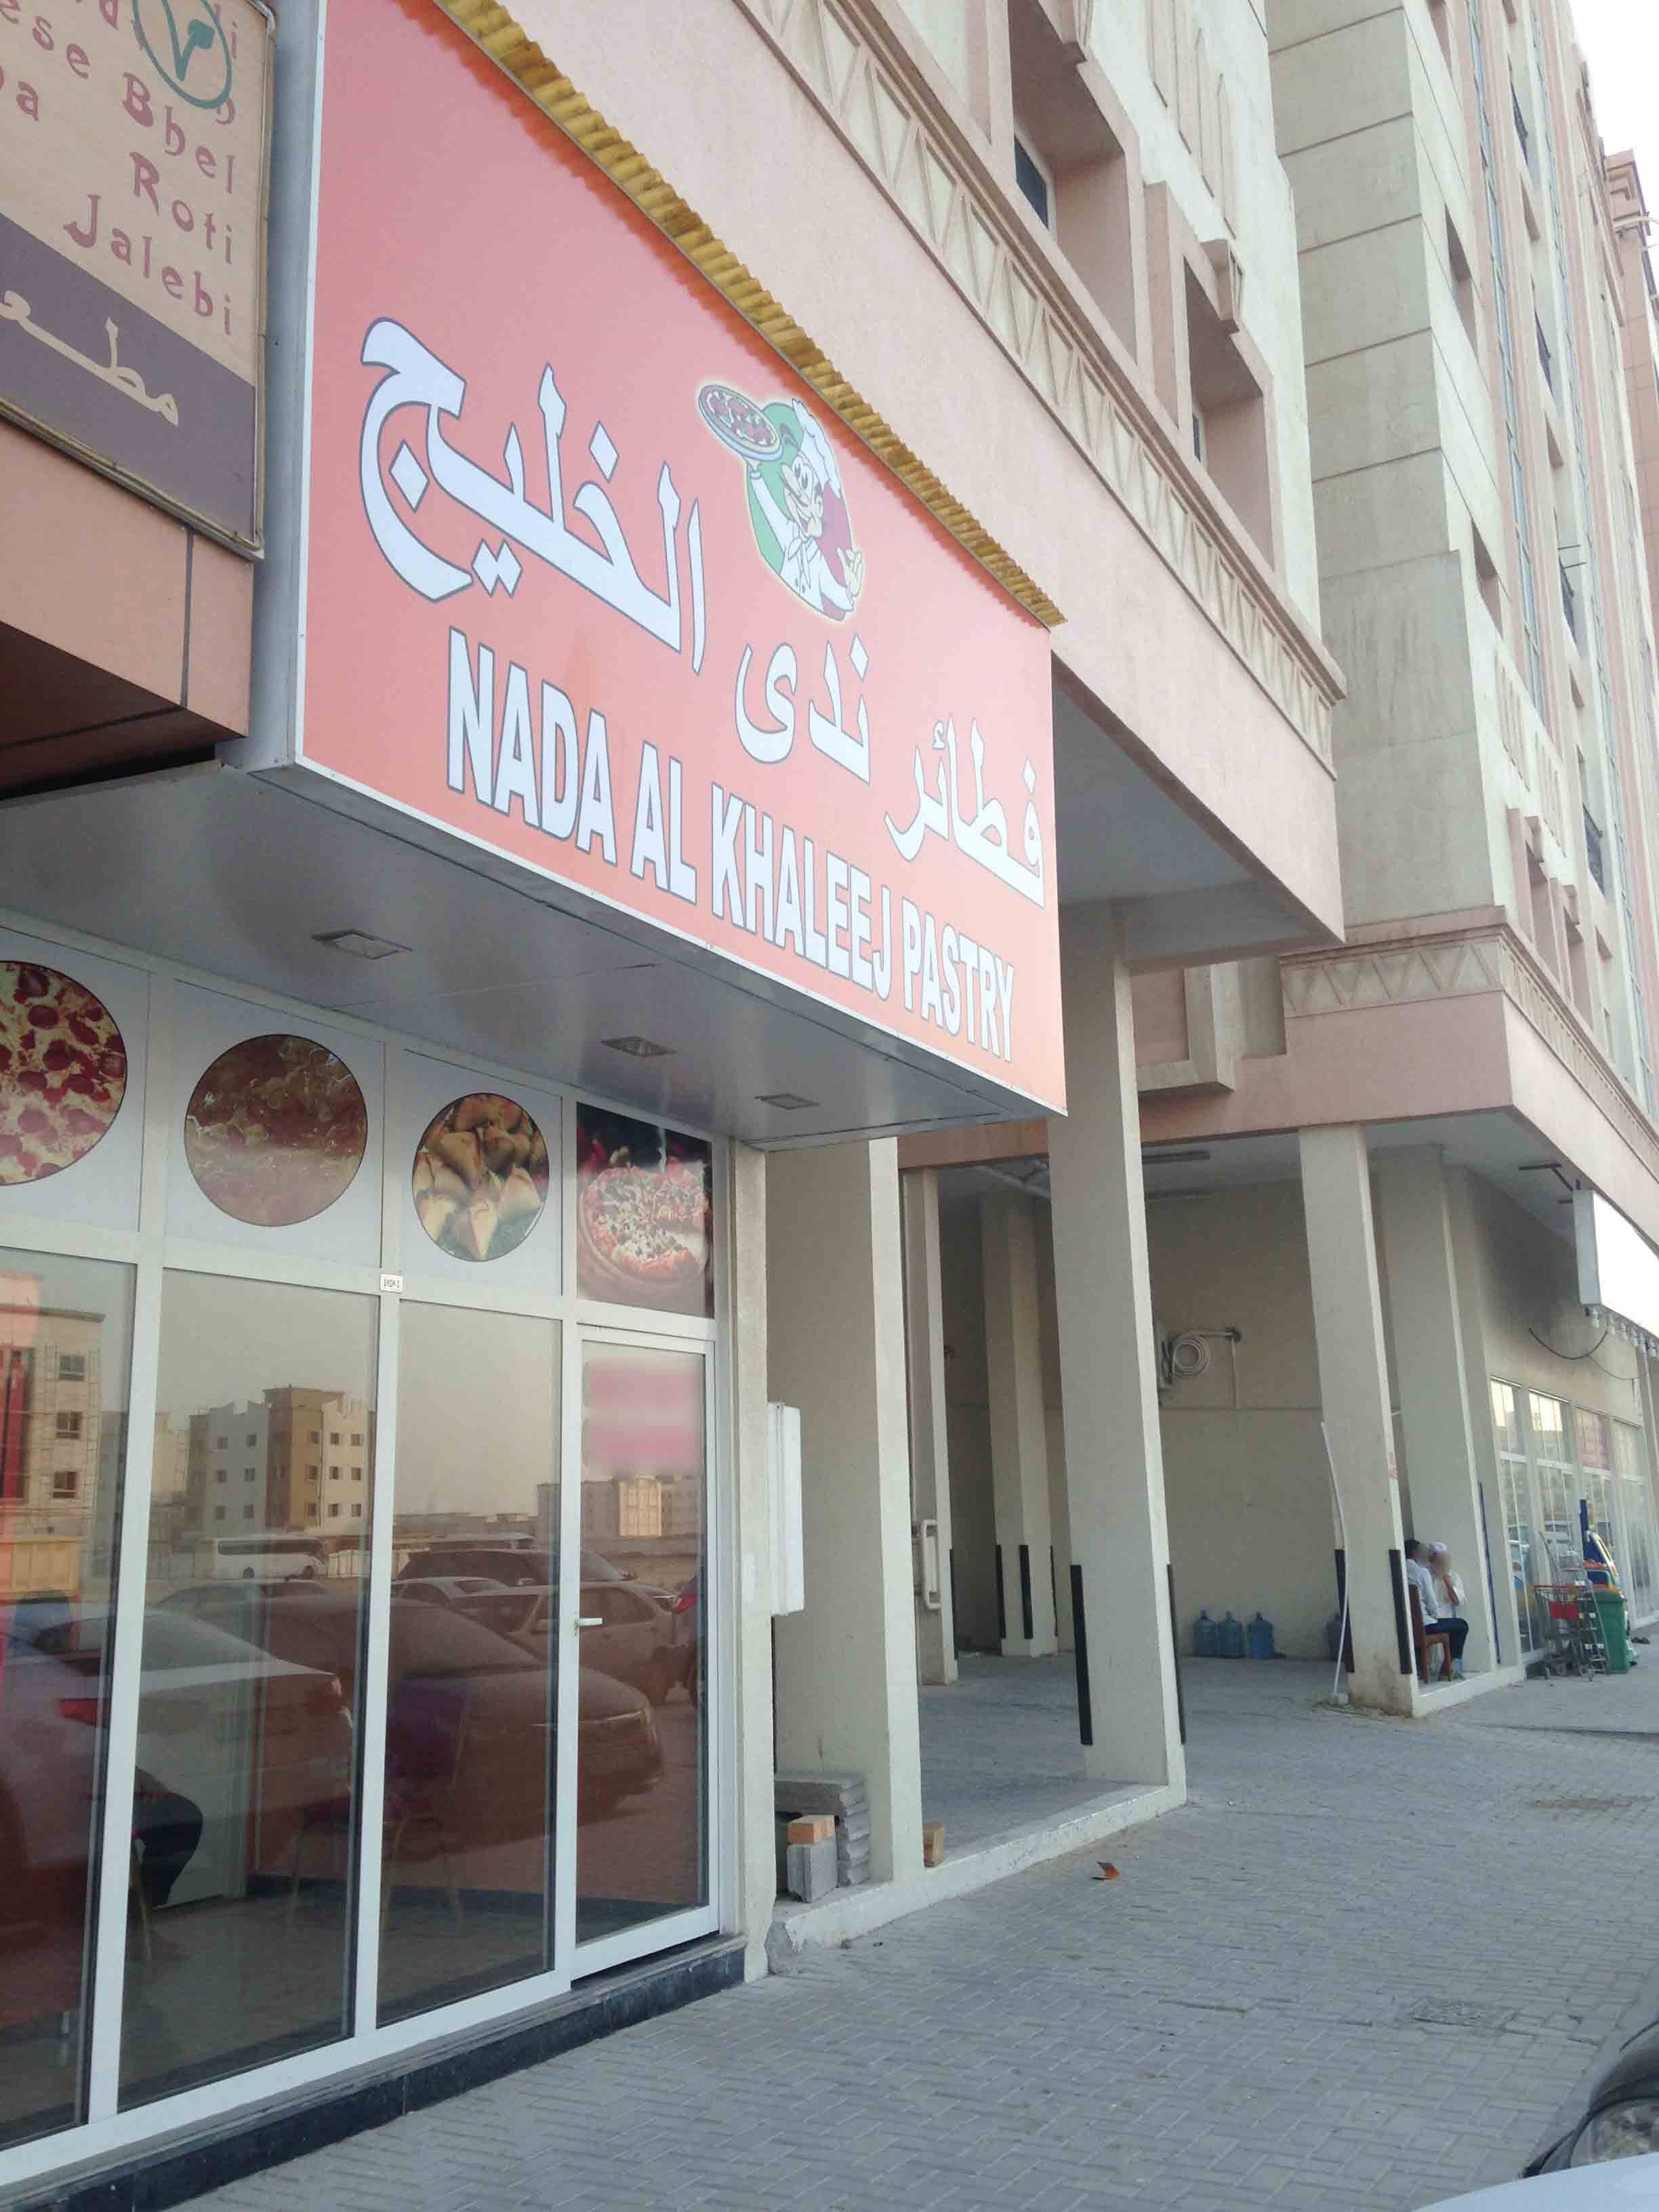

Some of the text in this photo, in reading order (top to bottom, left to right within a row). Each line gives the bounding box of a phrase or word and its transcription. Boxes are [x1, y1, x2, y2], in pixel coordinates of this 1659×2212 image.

[63, 194, 231, 335] Jalebi
[130, 151, 232, 264] Roti
[359, 316, 1046, 910] فطائر ندى الخليج
[445, 624, 1017, 1064] NADA AL KHALEEJ PASTRY
